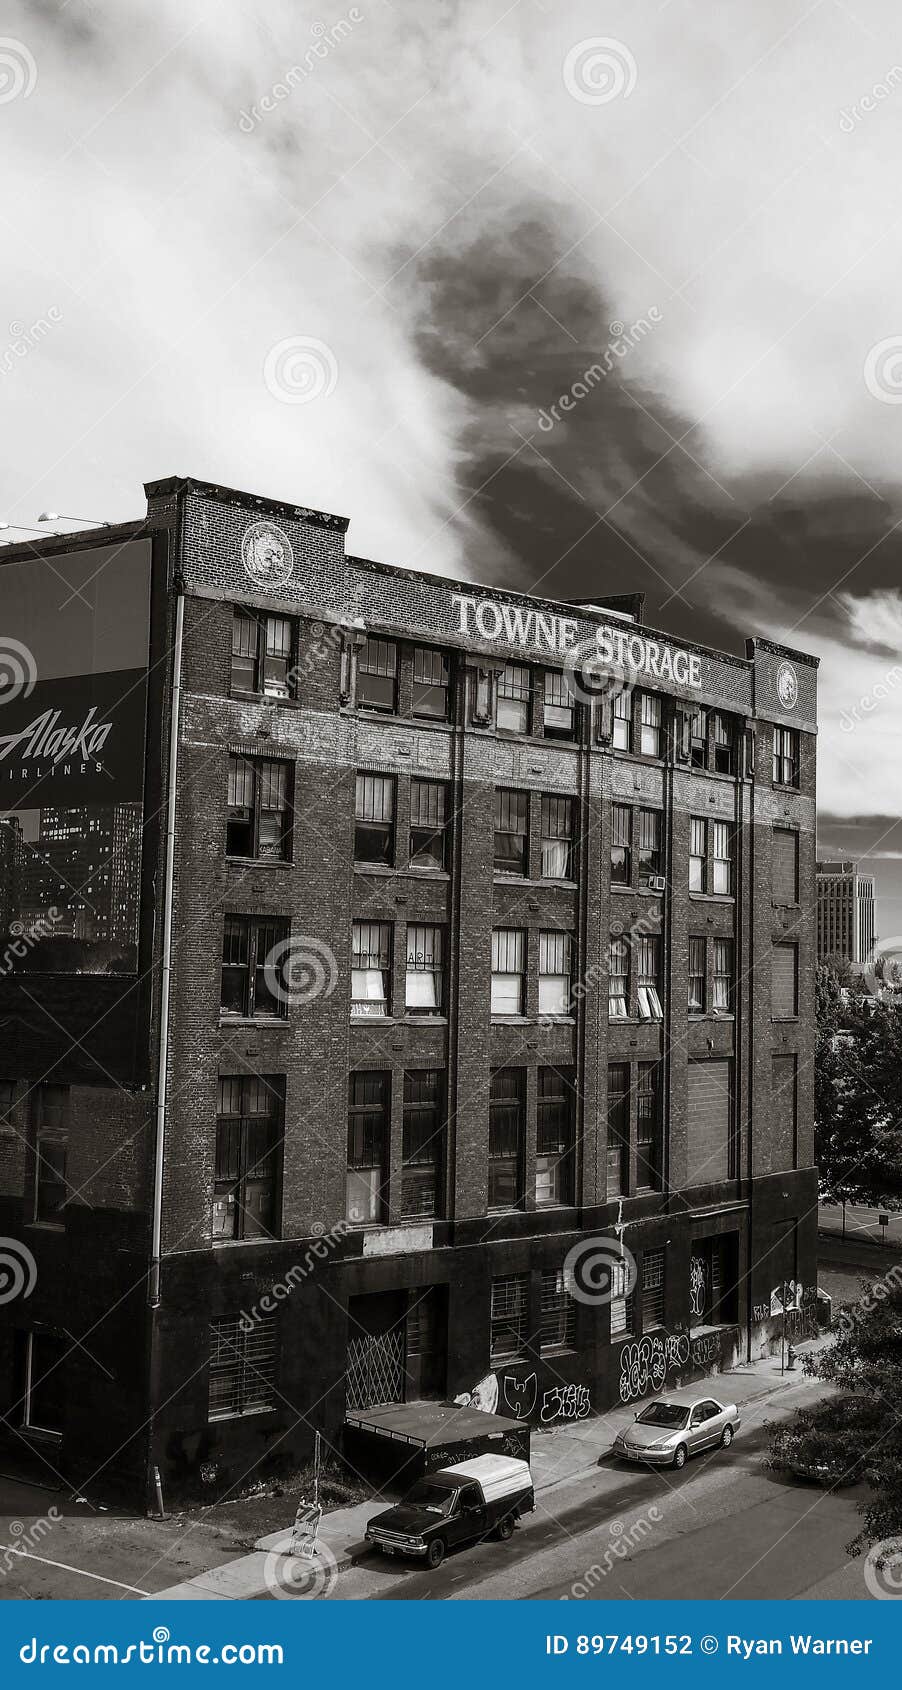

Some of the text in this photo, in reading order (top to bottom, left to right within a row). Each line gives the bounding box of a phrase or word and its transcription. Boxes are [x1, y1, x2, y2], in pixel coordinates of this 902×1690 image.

[451, 594, 702, 688] TOWNE STORAGE
[0, 706, 113, 763] Alaska
